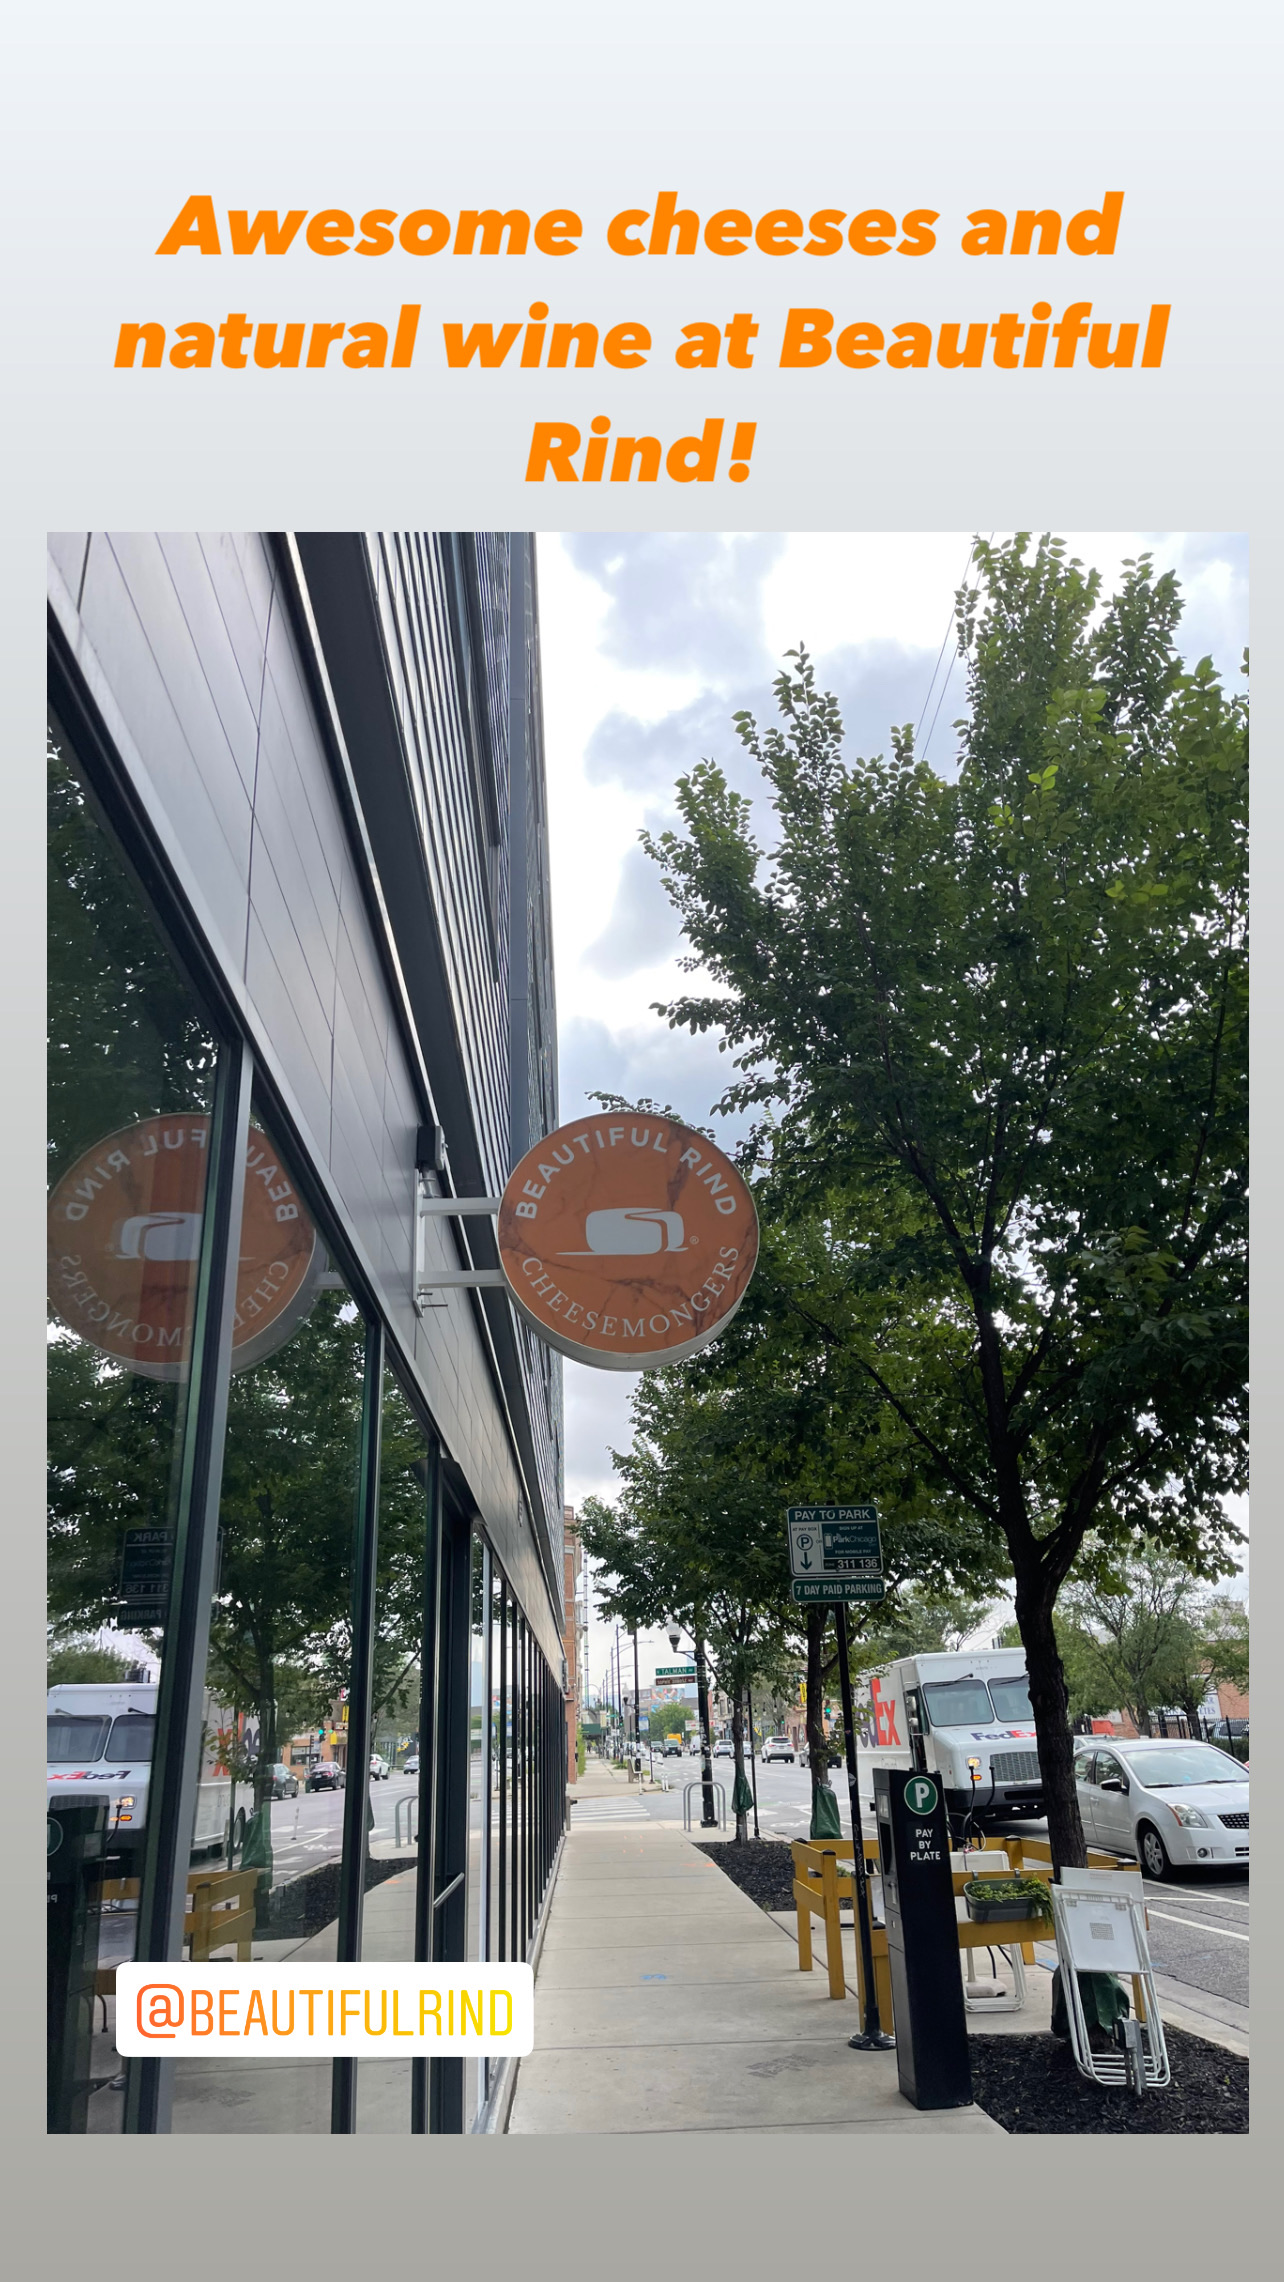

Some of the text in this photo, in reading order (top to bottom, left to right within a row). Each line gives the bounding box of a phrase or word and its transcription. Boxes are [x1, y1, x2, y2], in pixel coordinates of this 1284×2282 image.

[515, 1126, 738, 1219] BEAUTIFUL RIND
[522, 1246, 739, 1338] CHEESEMONGERS
[794, 1509, 870, 1520] PAY TO PARK
[837, 1559, 877, 1569] 311 136
[796, 1583, 882, 1595] 7 DAY PAID PARKING
[661, 1667, 687, 1675] TALMAN
[915, 1829, 933, 1838] PAY
[918, 1841, 931, 1849] BY
[910, 1851, 941, 1860] PLATE
